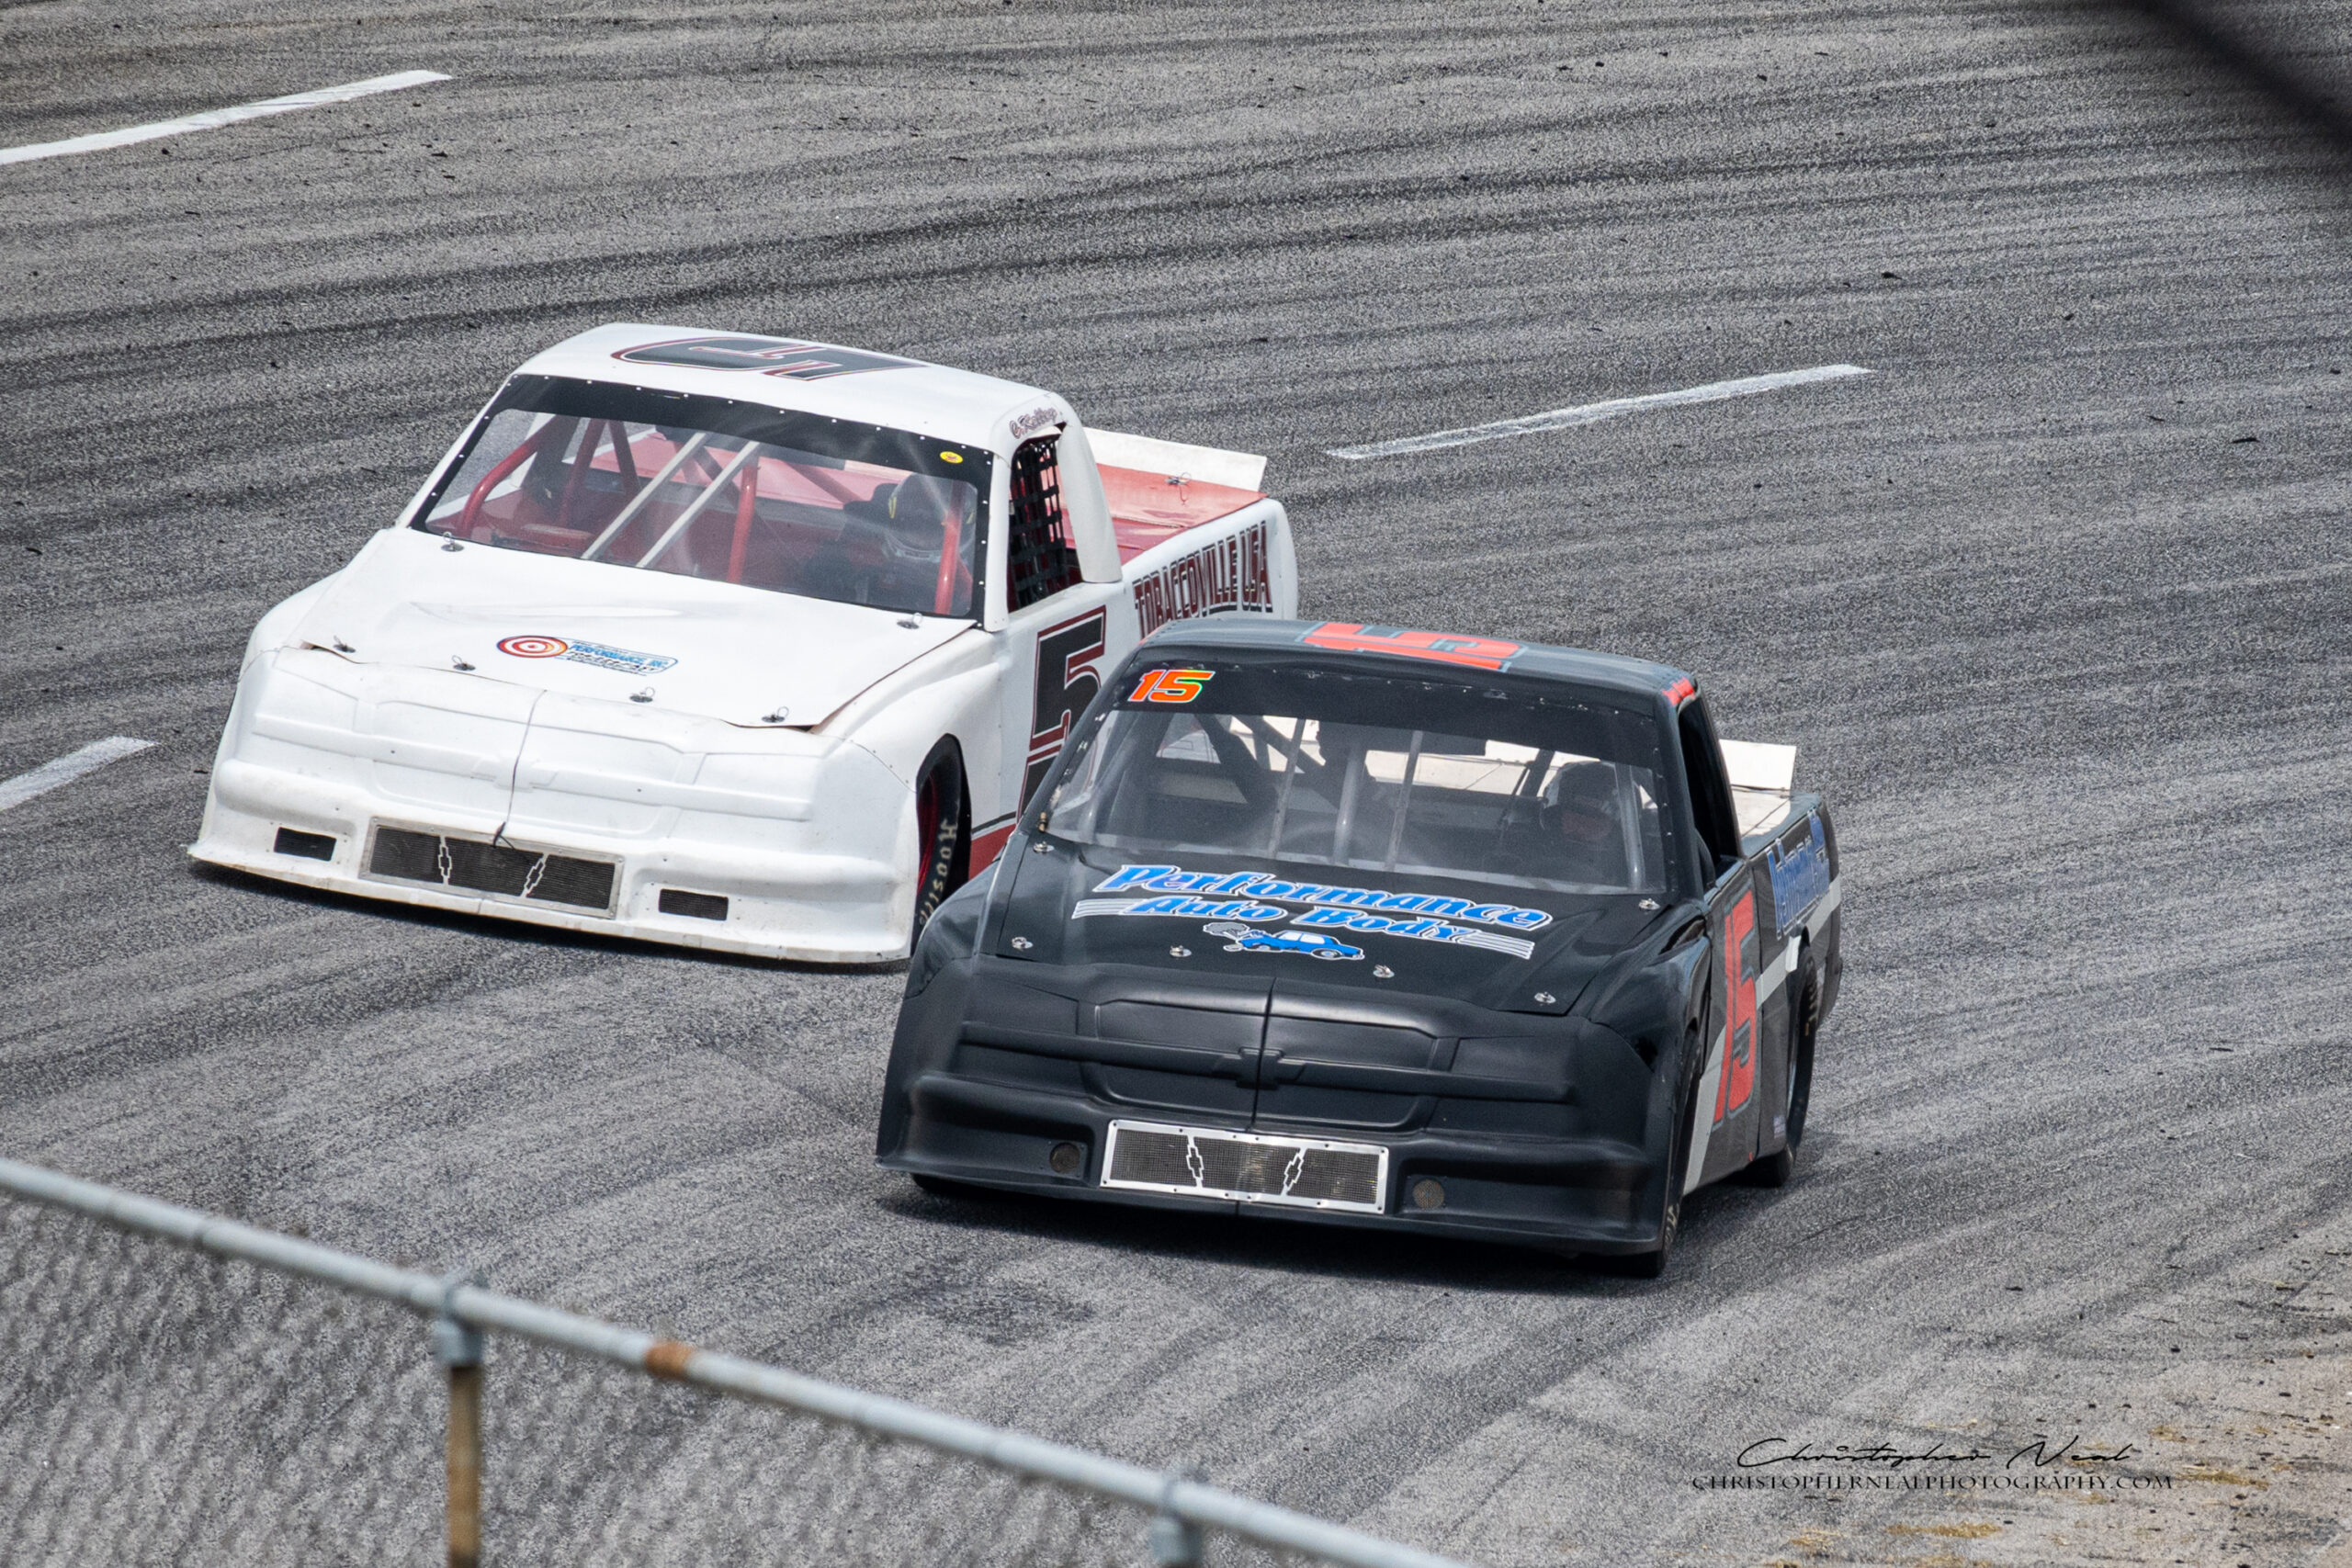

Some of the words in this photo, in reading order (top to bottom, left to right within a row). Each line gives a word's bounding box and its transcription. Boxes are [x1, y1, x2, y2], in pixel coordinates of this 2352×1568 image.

[1133, 535, 1237, 639] TOBACCOVILLE
[1239, 520, 1273, 613] USA
[1127, 669, 1216, 703] 15
[1091, 865, 1553, 931] Performance
[1118, 897, 1288, 920] Auto
[1290, 906, 1484, 943] Body
